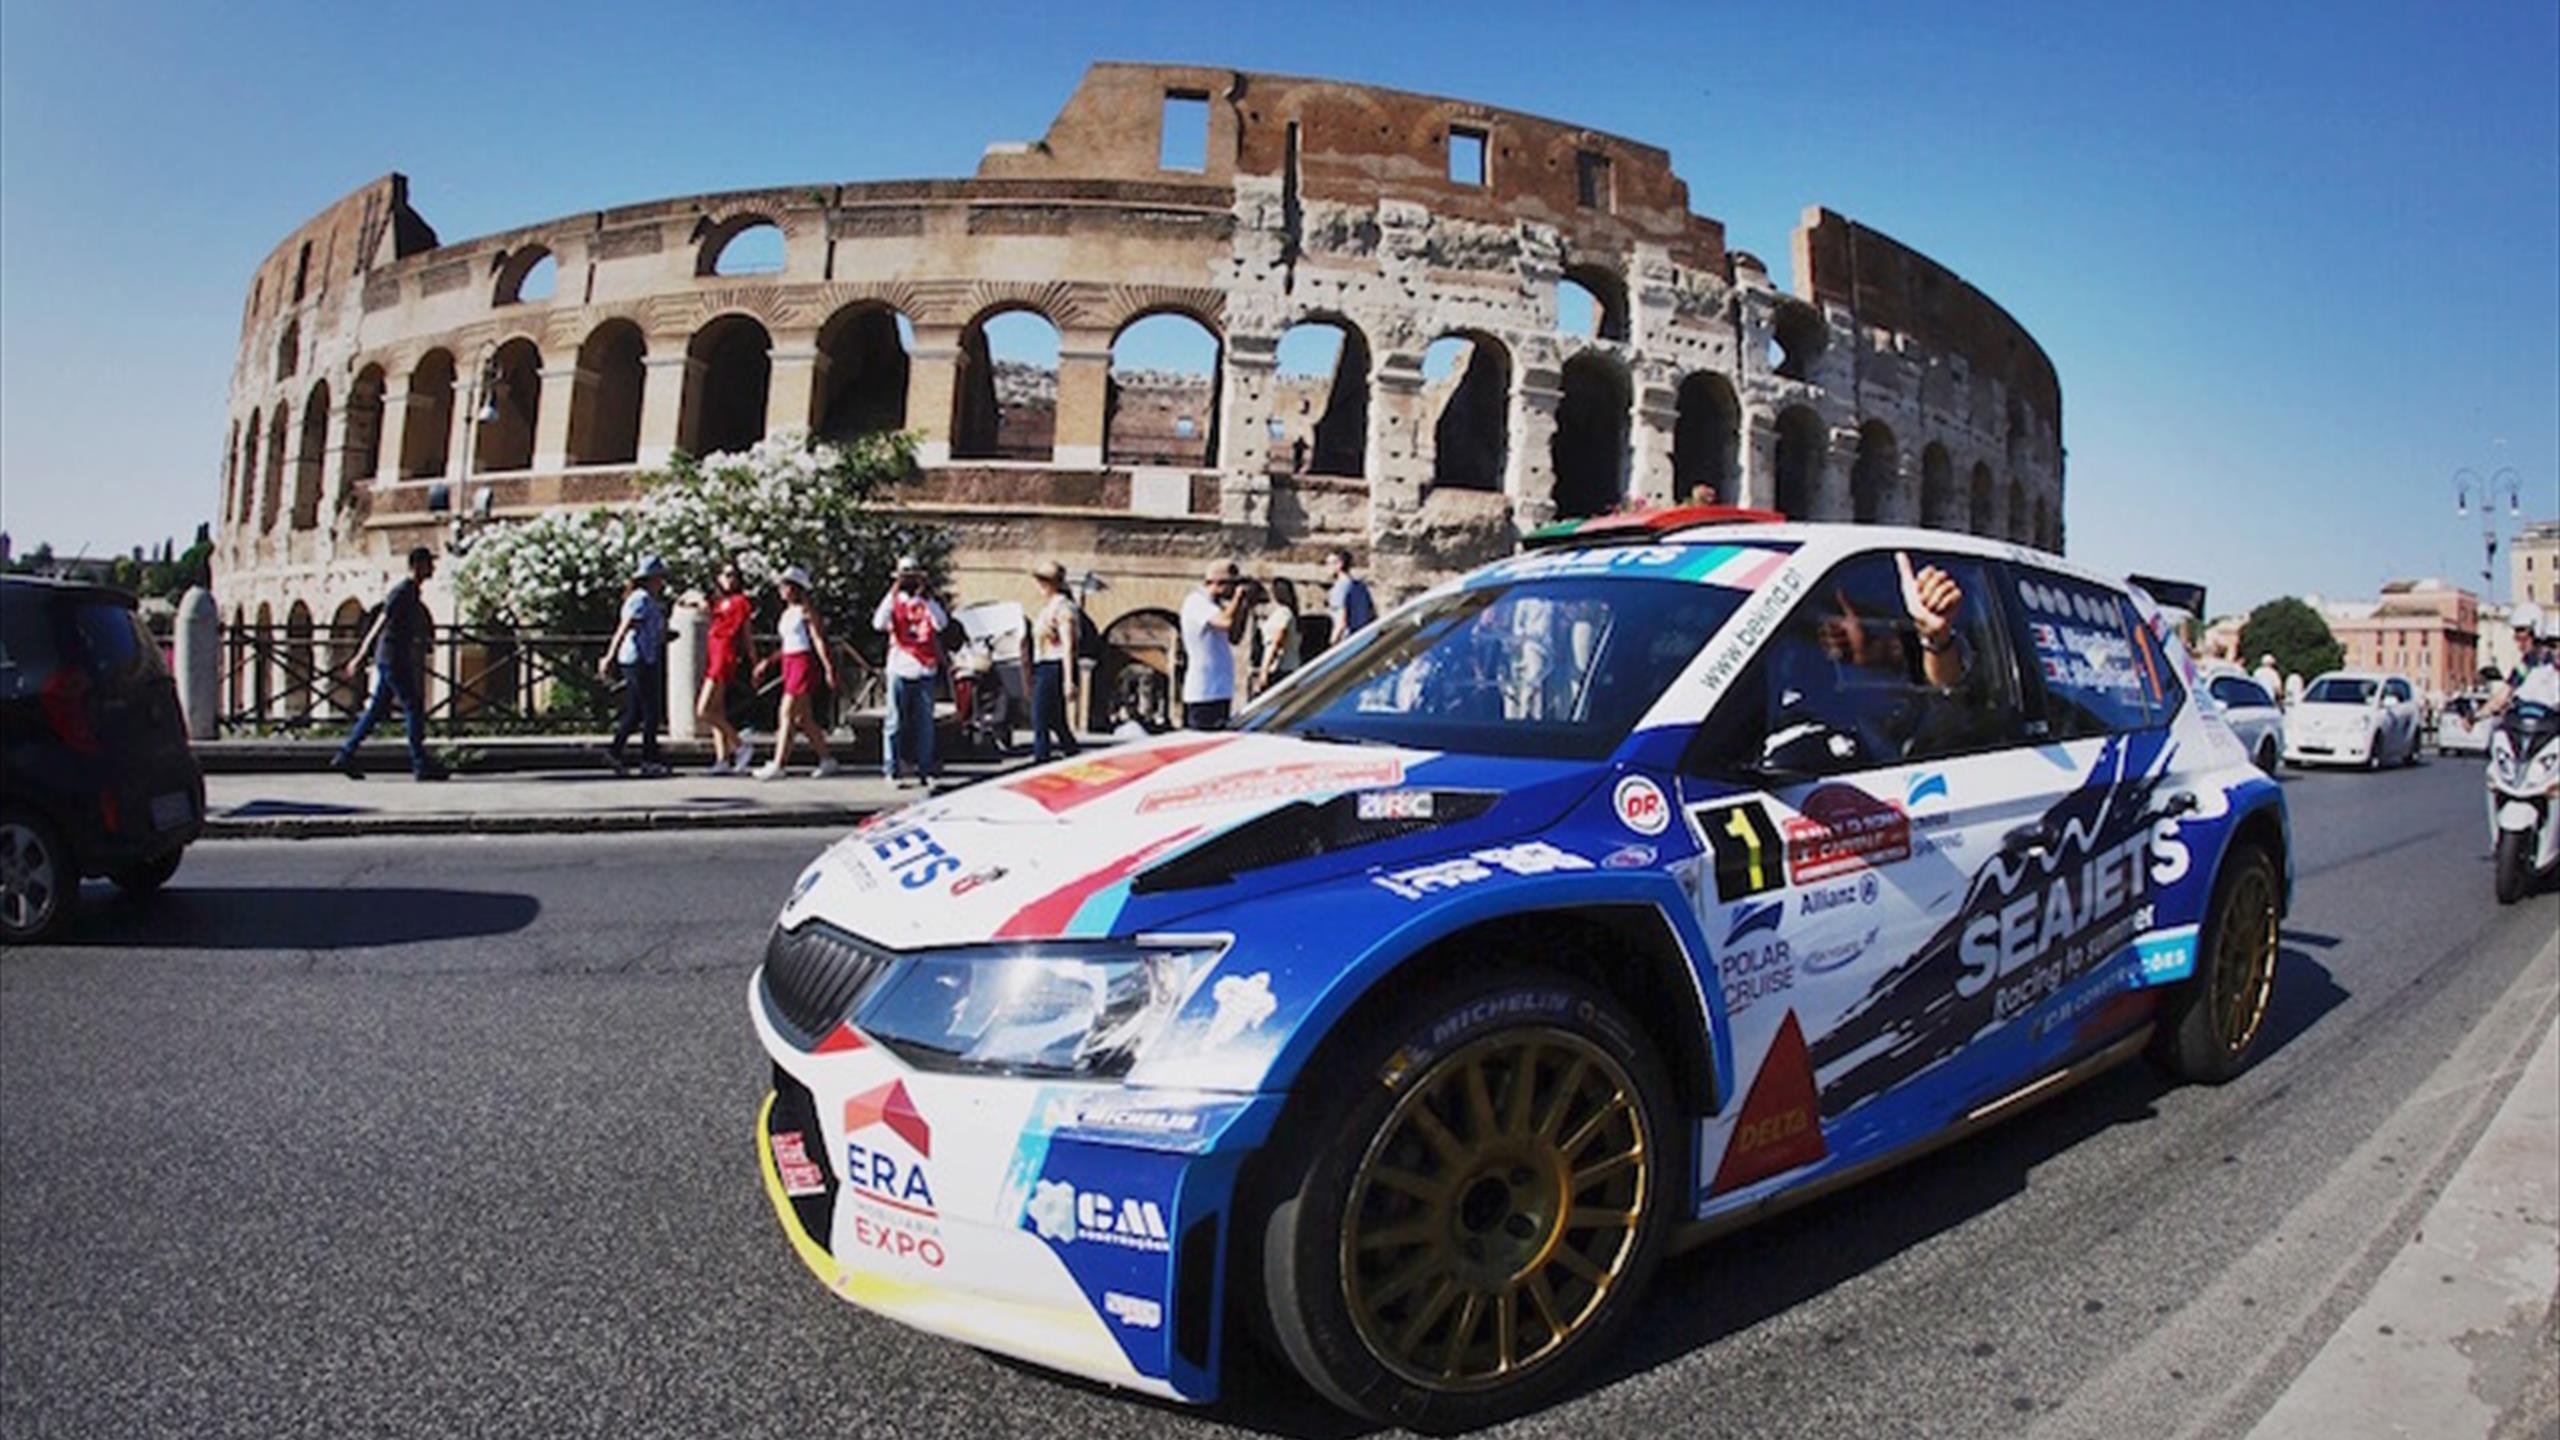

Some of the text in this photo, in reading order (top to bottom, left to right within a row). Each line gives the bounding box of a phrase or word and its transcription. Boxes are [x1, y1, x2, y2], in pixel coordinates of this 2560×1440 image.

[1626, 793, 1660, 818] DR
[1724, 807, 1765, 890] 1
[1800, 886, 1857, 916] Allianz
[1955, 816, 2190, 998] SEAJETS
[1722, 940, 1791, 979] POLAR
[1723, 965, 1796, 1004] CRUISE
[1431, 992, 1571, 1044] MICHELIN
[847, 1141, 934, 1207] ERA
[855, 1215, 946, 1268] EXPO
